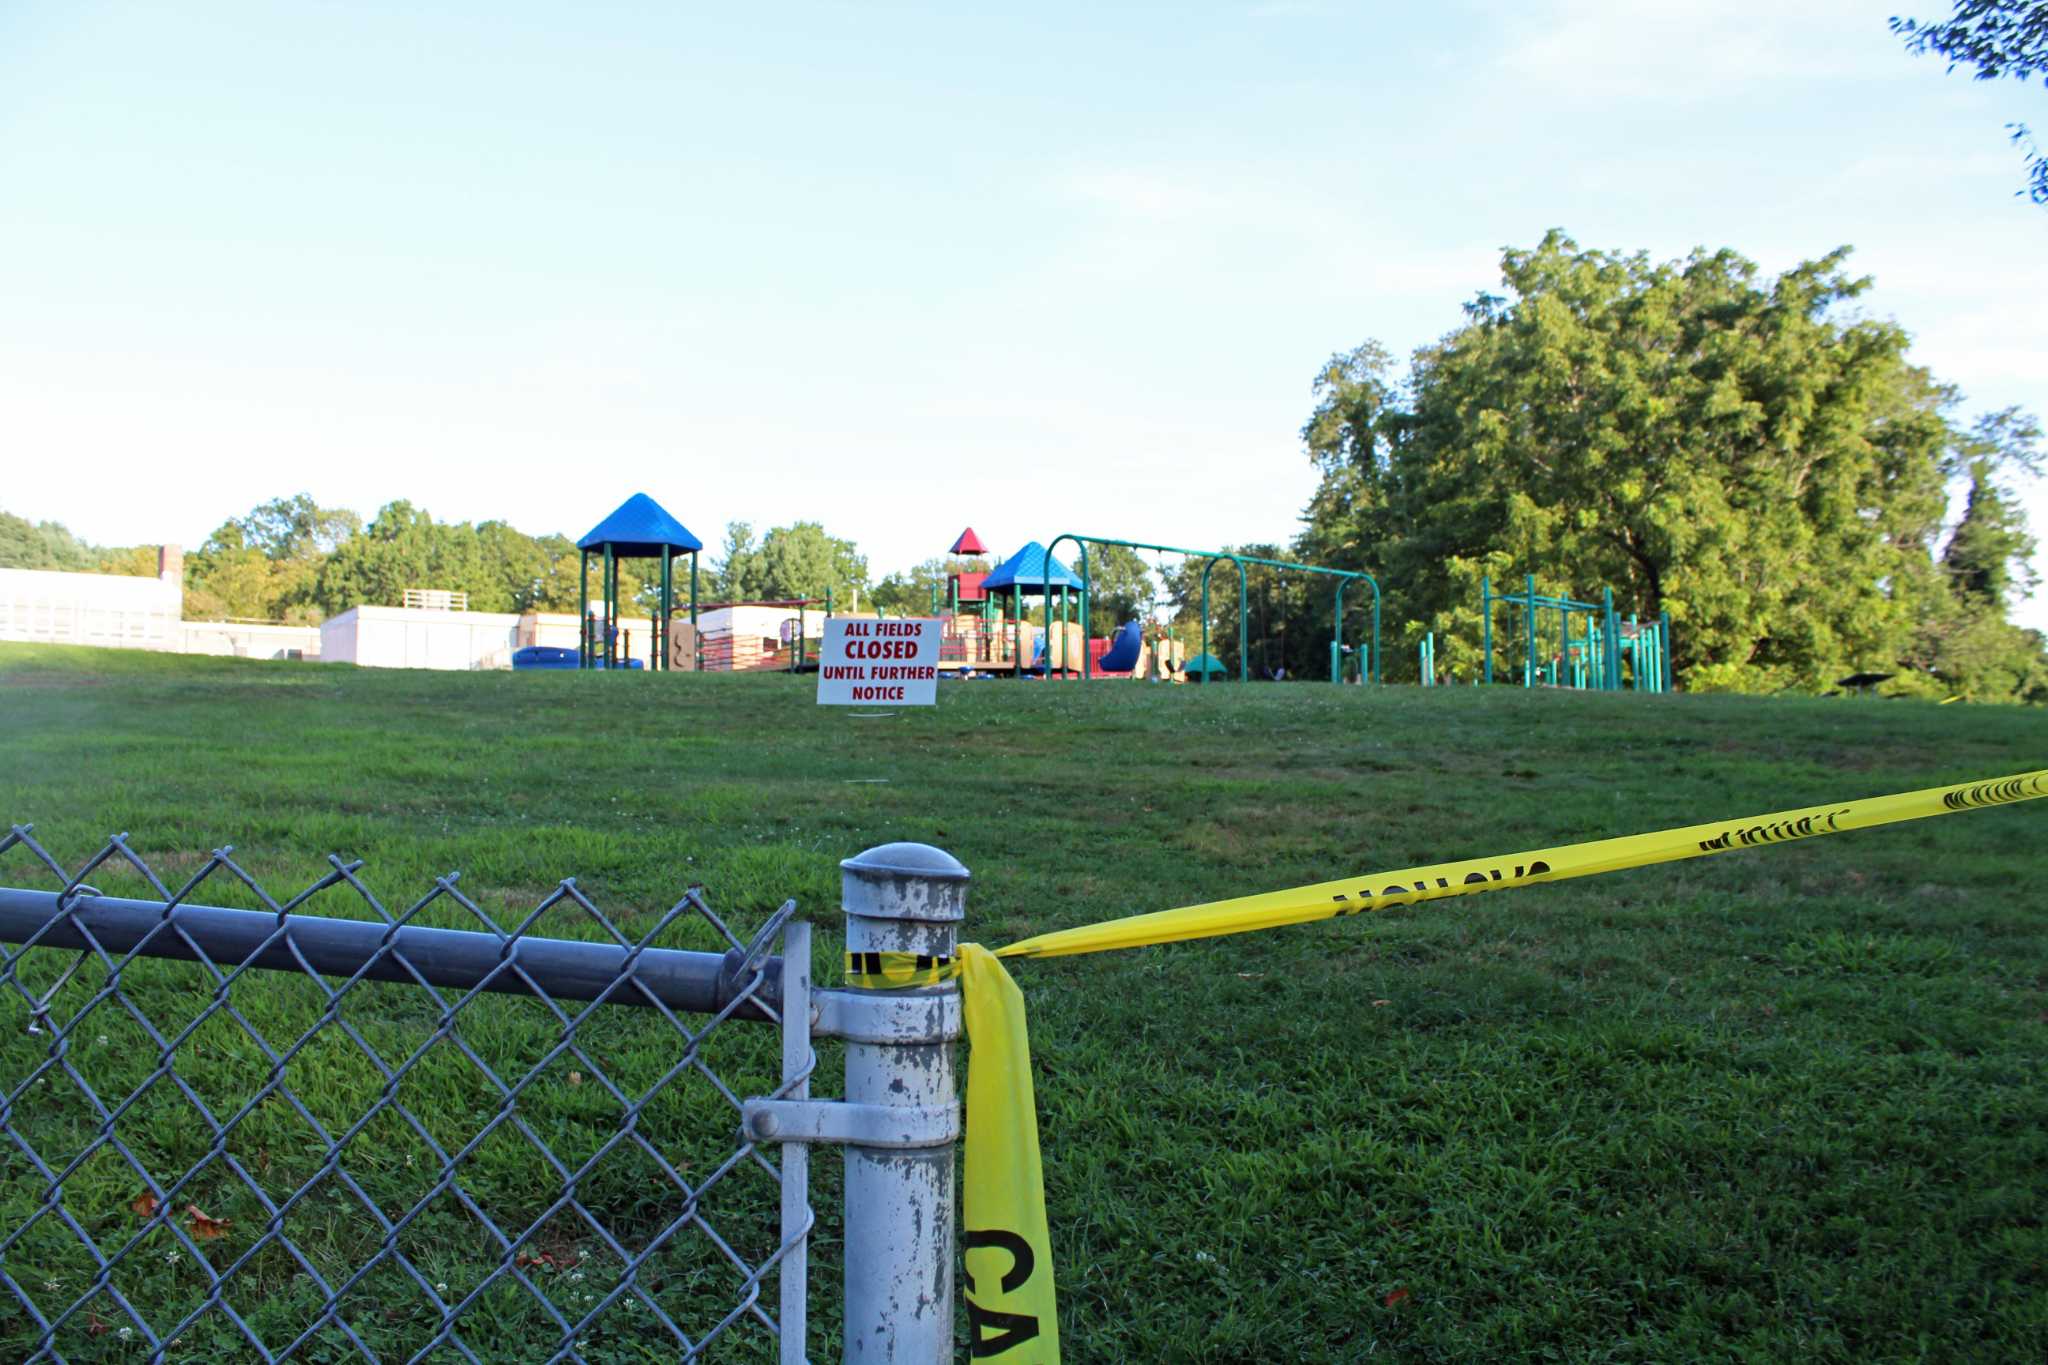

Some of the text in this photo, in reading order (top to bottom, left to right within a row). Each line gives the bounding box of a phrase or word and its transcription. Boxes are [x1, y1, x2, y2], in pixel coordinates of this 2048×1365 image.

[844, 623, 922, 637] ALL FIELDS
[845, 640, 918, 659] CLOSED
[823, 666, 935, 680] UNTIL FURTHER
[852, 687, 904, 700] NOTICE
